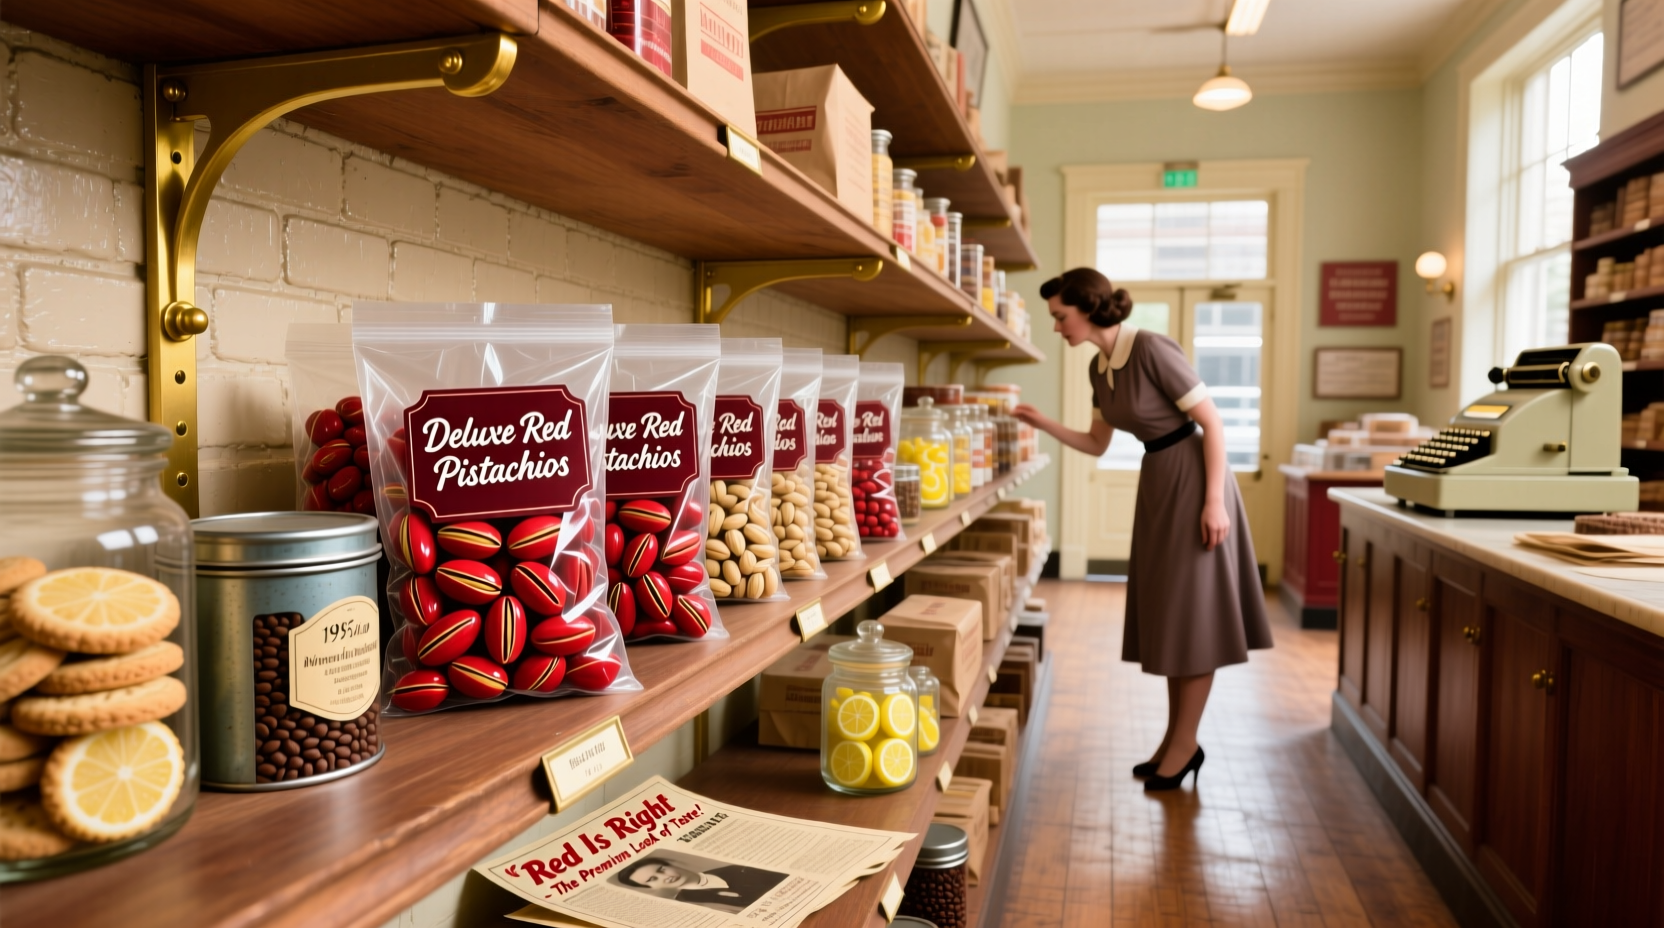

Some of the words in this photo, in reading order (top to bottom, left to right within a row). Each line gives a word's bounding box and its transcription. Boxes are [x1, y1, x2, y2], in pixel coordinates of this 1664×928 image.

[422, 417, 517, 453] Deluxe
[519, 408, 573, 444] Red
[606, 421, 637, 440] uxe
[640, 410, 685, 439] Red
[718, 411, 754, 434] Red
[604, 443, 681, 472] tachios
[710, 435, 752, 457] chios
[433, 449, 570, 492] Pistachios
[577, 832, 612, 856] Is
[603, 793, 676, 840] Right
[549, 879, 580, 898] The
